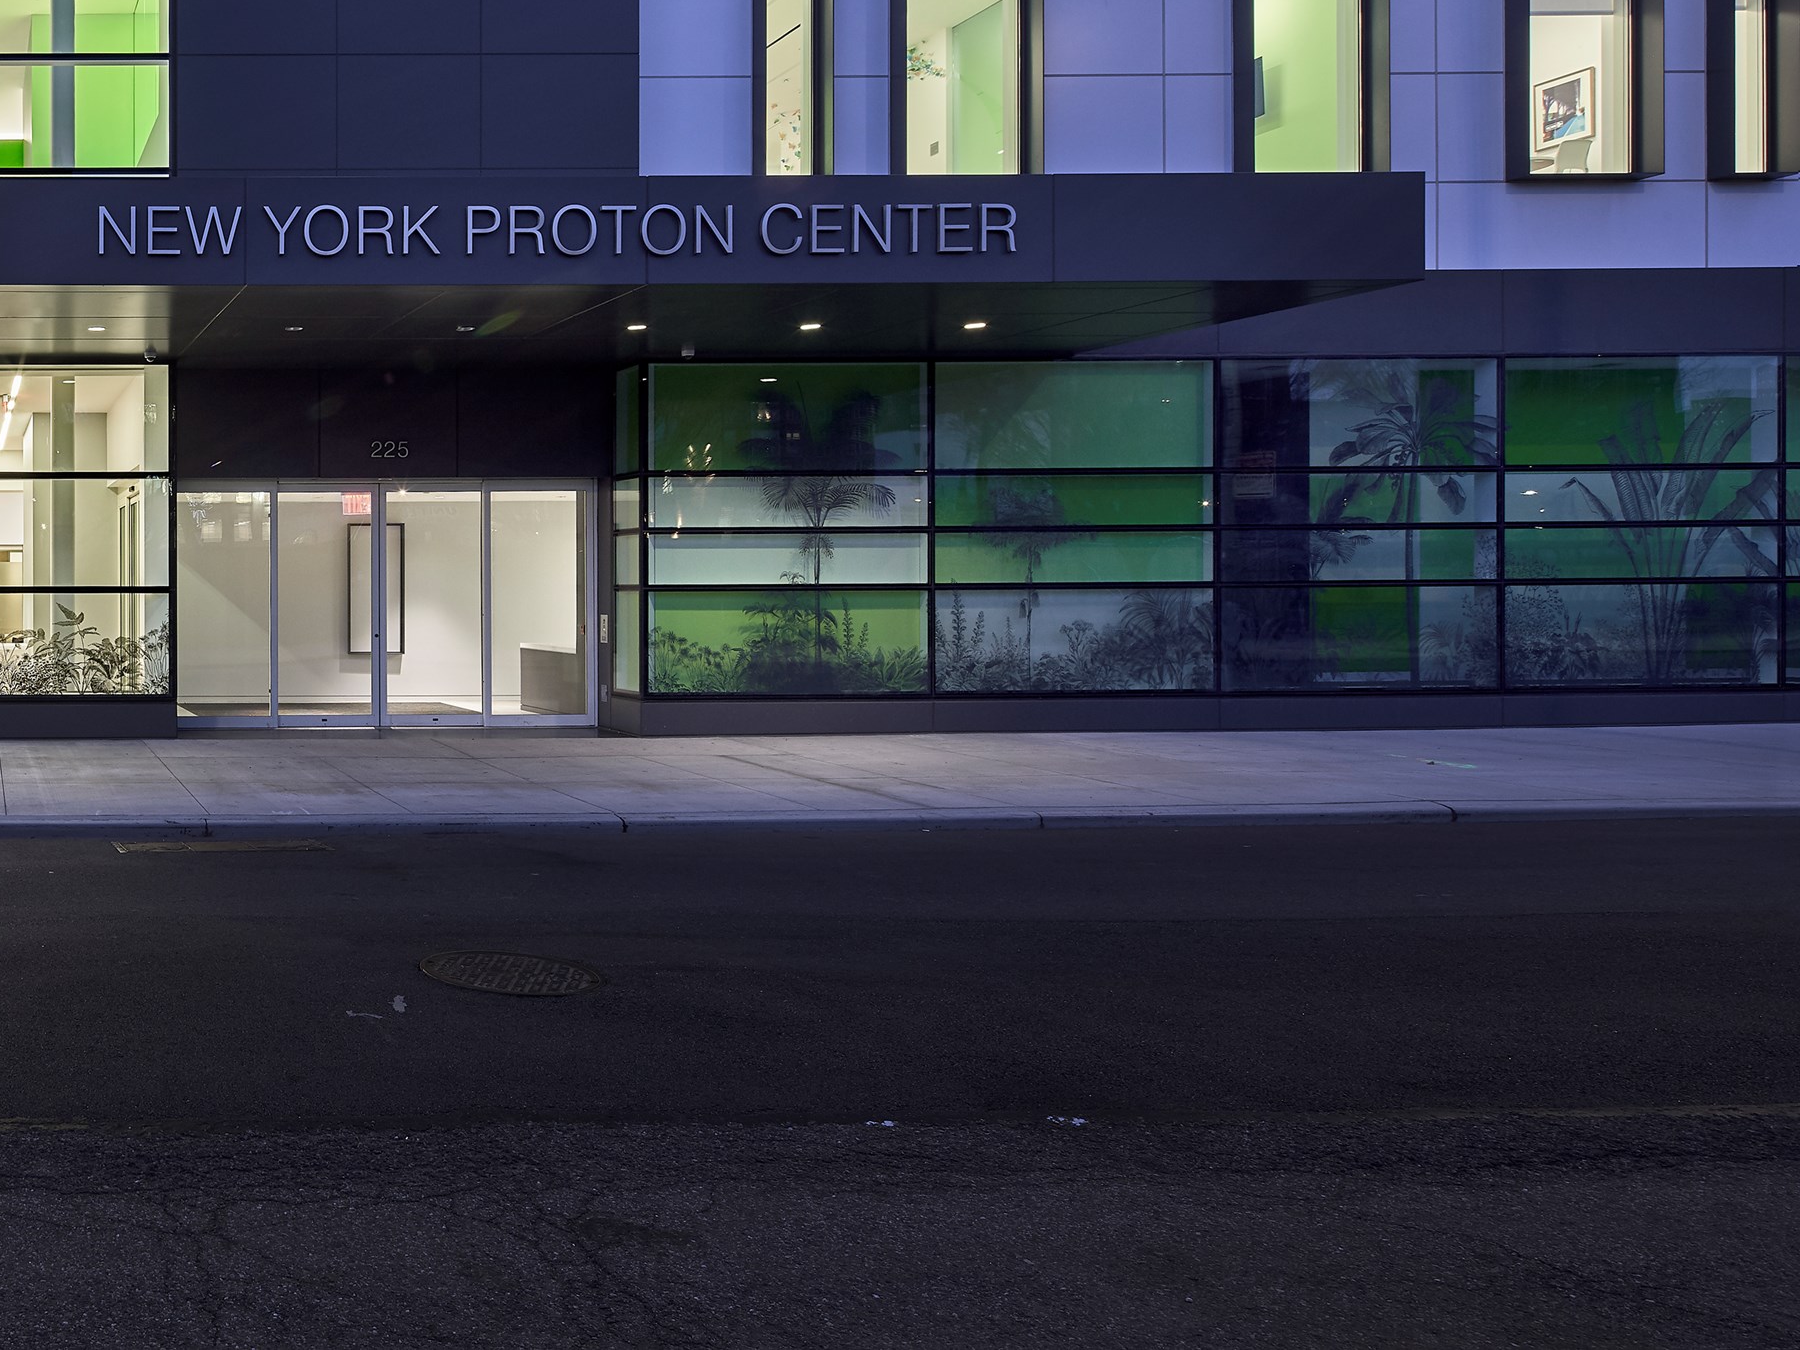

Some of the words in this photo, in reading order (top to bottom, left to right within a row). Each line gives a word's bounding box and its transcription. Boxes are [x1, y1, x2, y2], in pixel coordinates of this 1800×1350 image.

[98, 204, 242, 255] NEW
[262, 204, 441, 256] YORK
[466, 203, 734, 256] PROTON
[759, 202, 1017, 254] CENTER
[370, 440, 409, 458] 225
